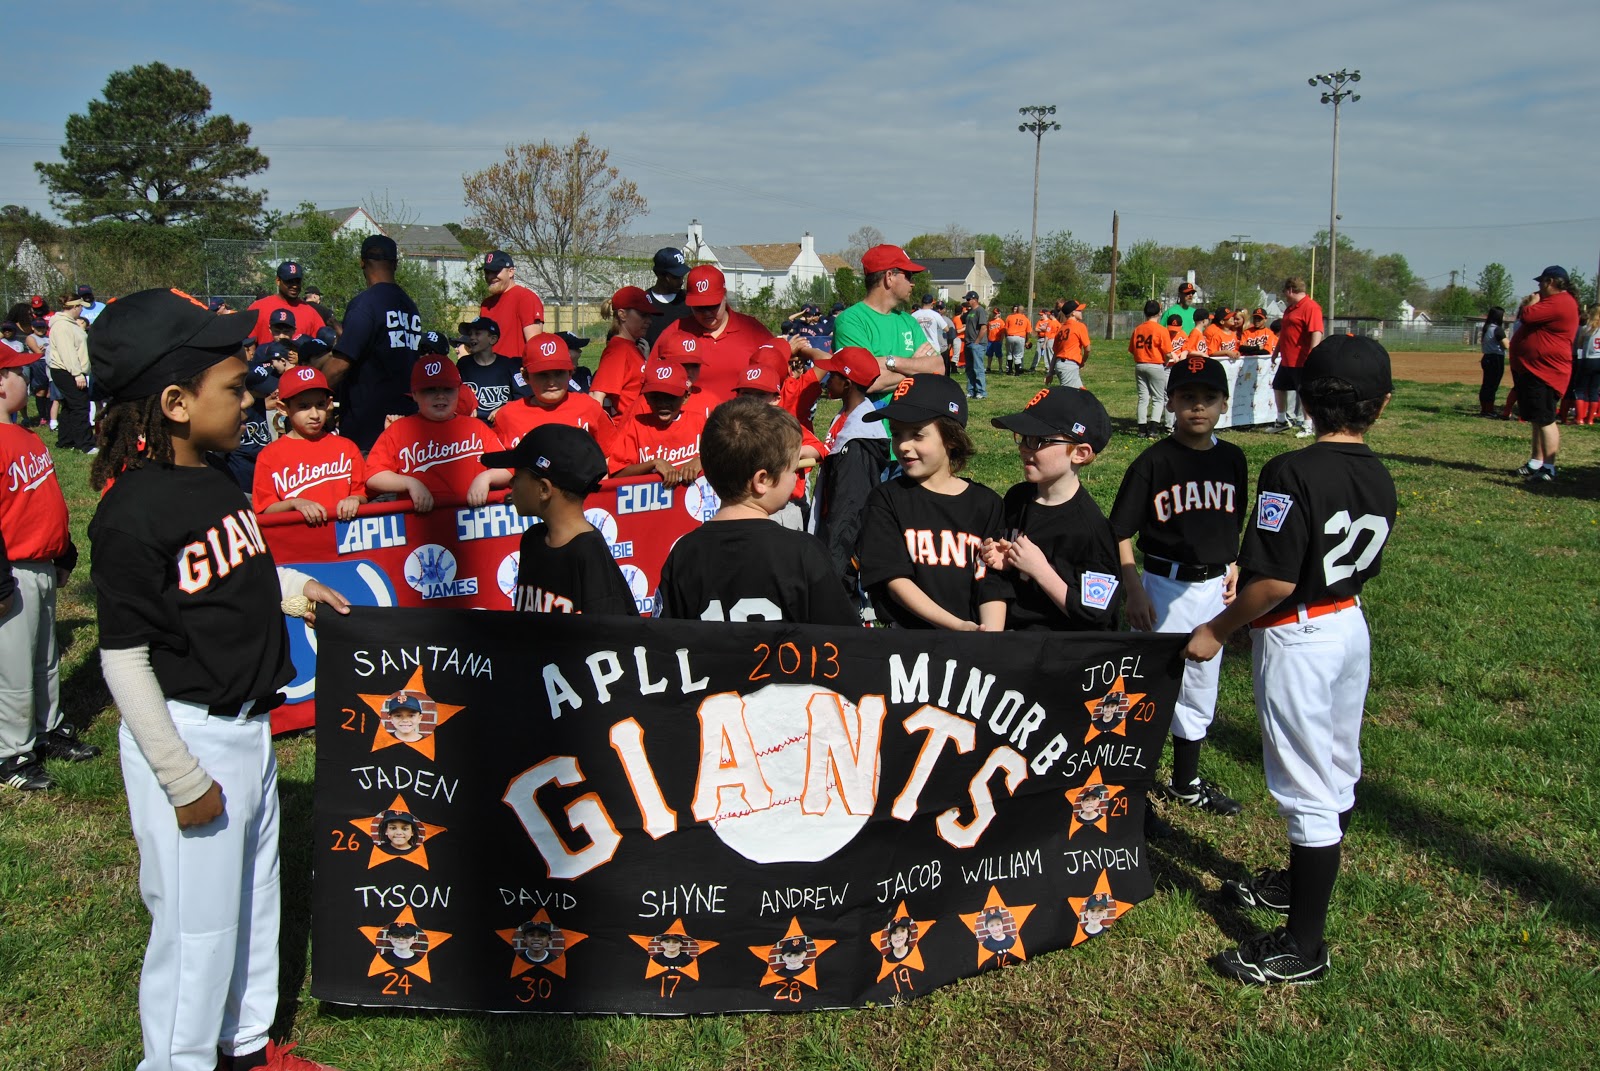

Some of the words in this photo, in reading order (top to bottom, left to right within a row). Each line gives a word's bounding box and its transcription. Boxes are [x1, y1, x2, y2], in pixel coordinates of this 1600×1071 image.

[289, 264, 297, 274] B
[696, 279, 709, 293] W
[279, 311, 287, 321] B
[540, 341, 557, 357] W
[682, 339, 696, 352] W
[1135, 334, 1153, 349] 24
[298, 368, 315, 381] W
[425, 361, 442, 377] W
[656, 367, 672, 380] W
[747, 368, 761, 381] W
[399, 433, 484, 473] Nationals
[272, 452, 352, 496] Nationals
[1154, 480, 1236, 522] GIANT
[338, 515, 406, 554] APLL
[1323, 510, 1390, 586] 20
[423, 580, 477, 599] JAMES
[353, 645, 493, 681] SANTANA
[1082, 655, 1145, 692] JOEL
[341, 708, 366, 734] 21
[541, 646, 709, 719] APLL
[748, 642, 841, 681] 2013
[889, 653, 1047, 750] MINOR
[1030, 732, 1068, 776] B
[1134, 702, 1155, 722] 20
[1062, 743, 1146, 777] SAMUEL
[351, 765, 459, 803] JADEN
[501, 690, 1028, 881] GIANTS
[1111, 797, 1128, 816] 29
[330, 829, 360, 852] 26
[962, 849, 1042, 884] WILLIAM
[1064, 847, 1140, 874] JAYDEN
[877, 860, 942, 903] JACOB
[355, 884, 451, 908] TYSON
[499, 887, 577, 911] DAVID
[639, 883, 727, 918] SHYNE
[760, 883, 849, 916] ANDREW
[381, 972, 413, 996] 24
[515, 976, 552, 1003] 30
[660, 975, 681, 999] 17
[774, 981, 802, 1003] 28
[893, 968, 914, 993] 19
